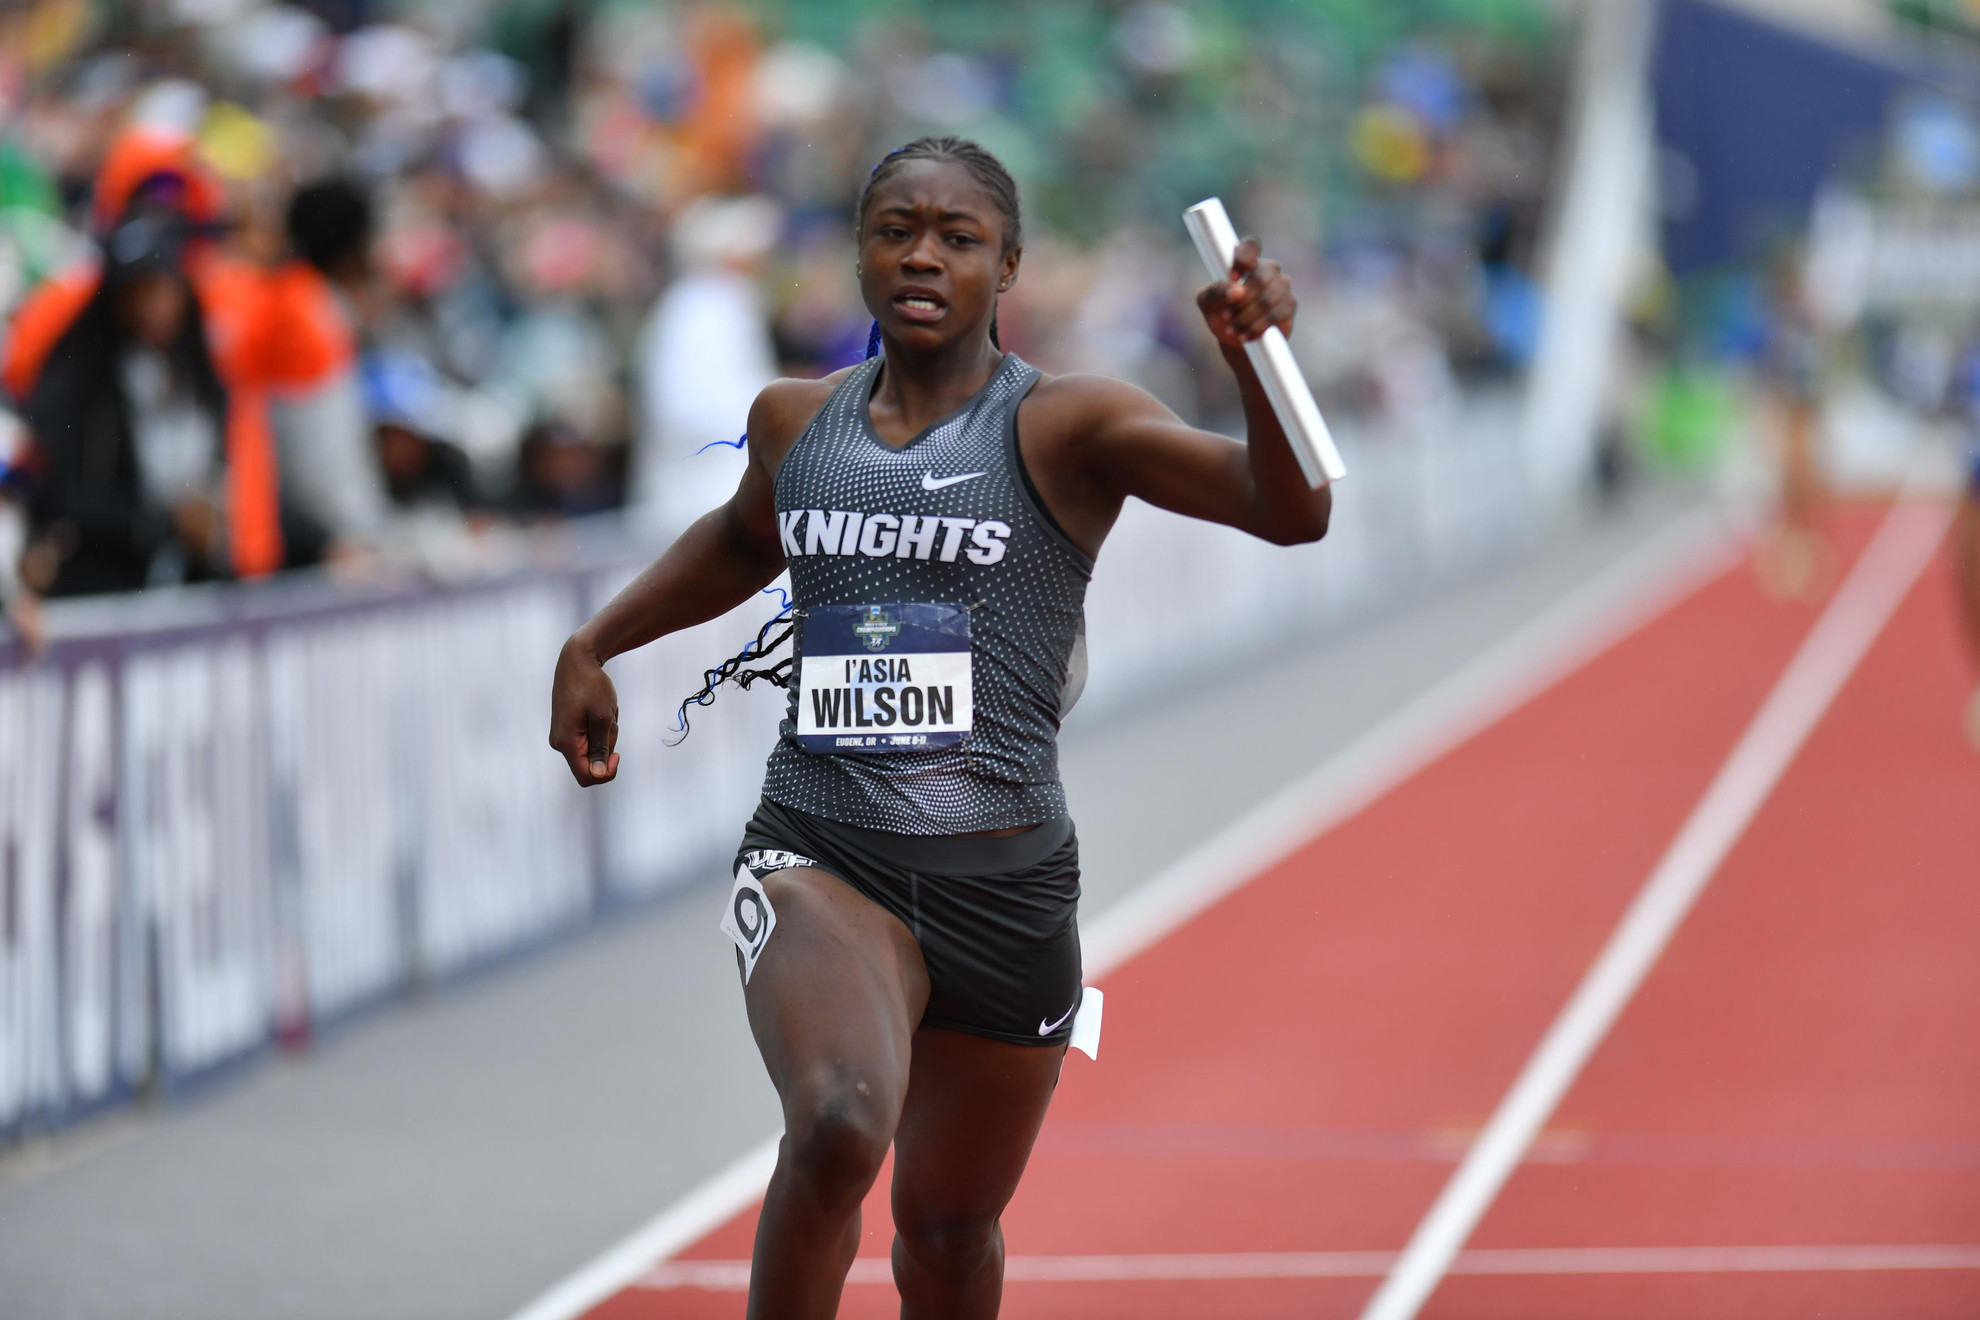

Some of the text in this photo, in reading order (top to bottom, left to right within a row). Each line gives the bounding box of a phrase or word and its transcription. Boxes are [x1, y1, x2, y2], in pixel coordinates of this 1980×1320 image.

[778, 509, 1011, 565] KNIGHTS
[845, 658, 912, 684] I'ASIA
[812, 685, 954, 728] WILSON
[836, 737, 864, 747] EUGENE,
[866, 737, 877, 746] OR
[890, 736, 911, 746] JUNE
